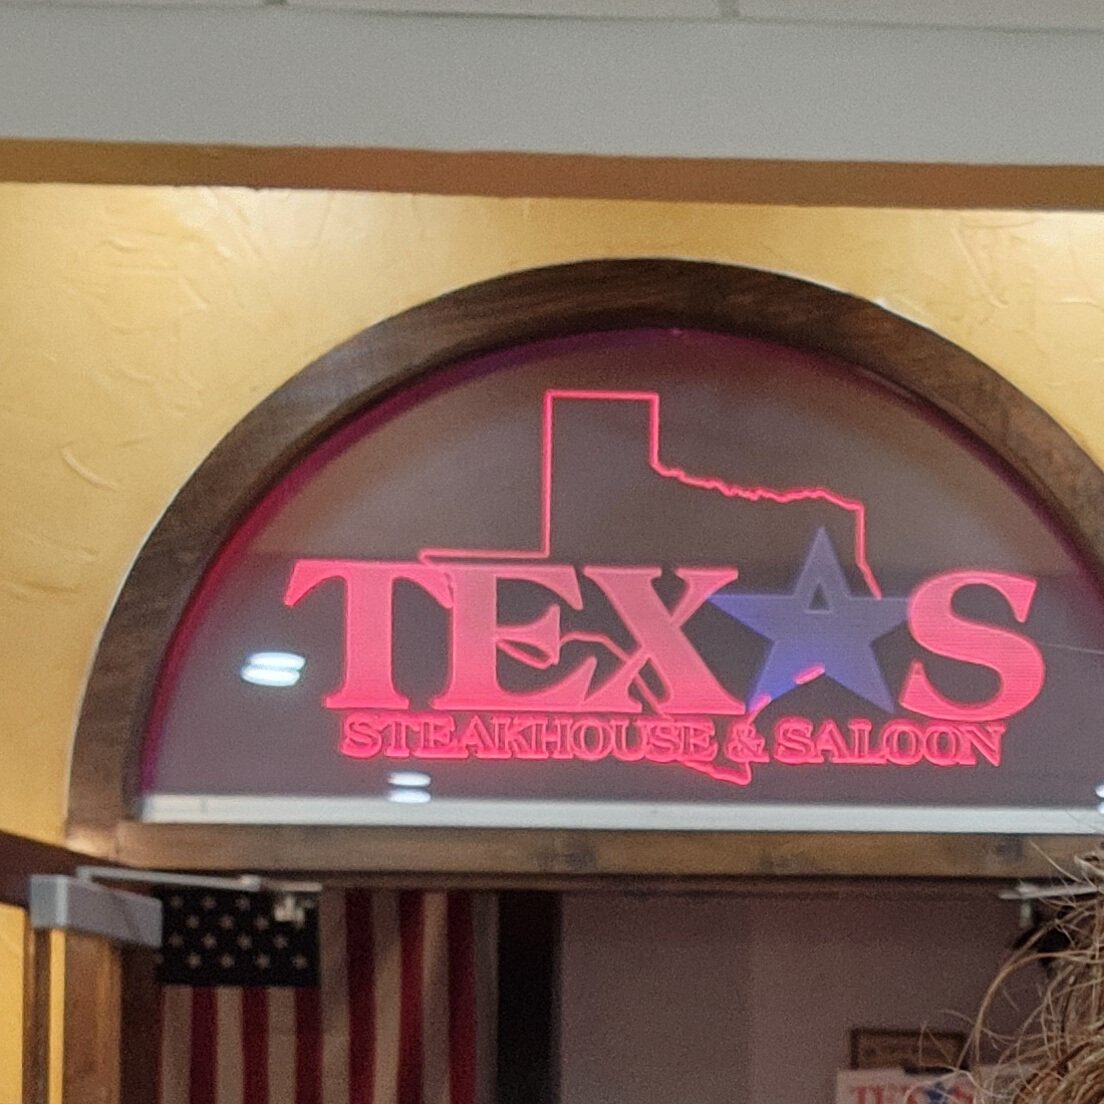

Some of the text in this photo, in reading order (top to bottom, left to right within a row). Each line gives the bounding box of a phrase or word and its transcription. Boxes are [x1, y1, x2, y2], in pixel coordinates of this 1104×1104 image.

[284, 527, 1046, 722] TEXAS
[341, 710, 1007, 768] STEAKHOUSE & SALOON
